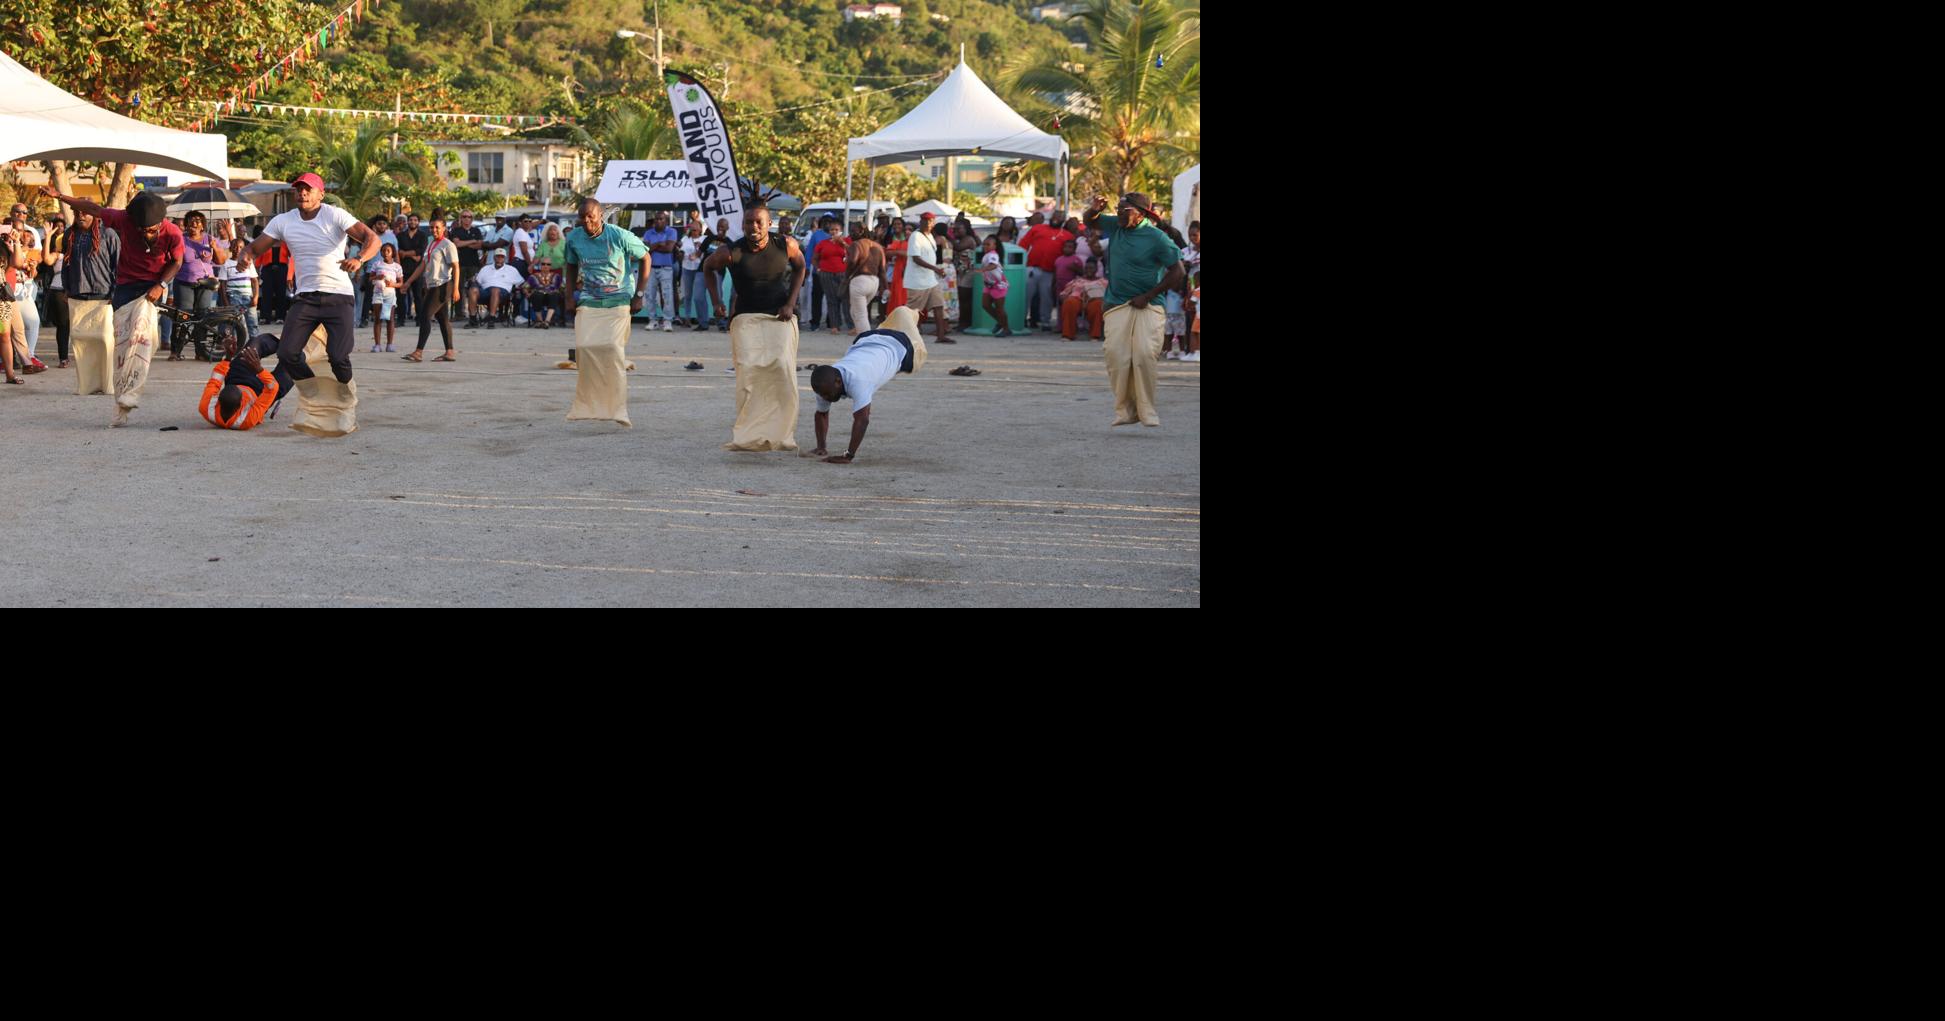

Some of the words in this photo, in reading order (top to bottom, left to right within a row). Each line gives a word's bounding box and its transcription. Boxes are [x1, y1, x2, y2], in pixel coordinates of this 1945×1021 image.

[618, 180, 693, 188] FLAVOUR
[621, 170, 690, 180] ISLAN
[679, 109, 723, 219] ISLAND
[700, 105, 739, 215] FLAVOURS
